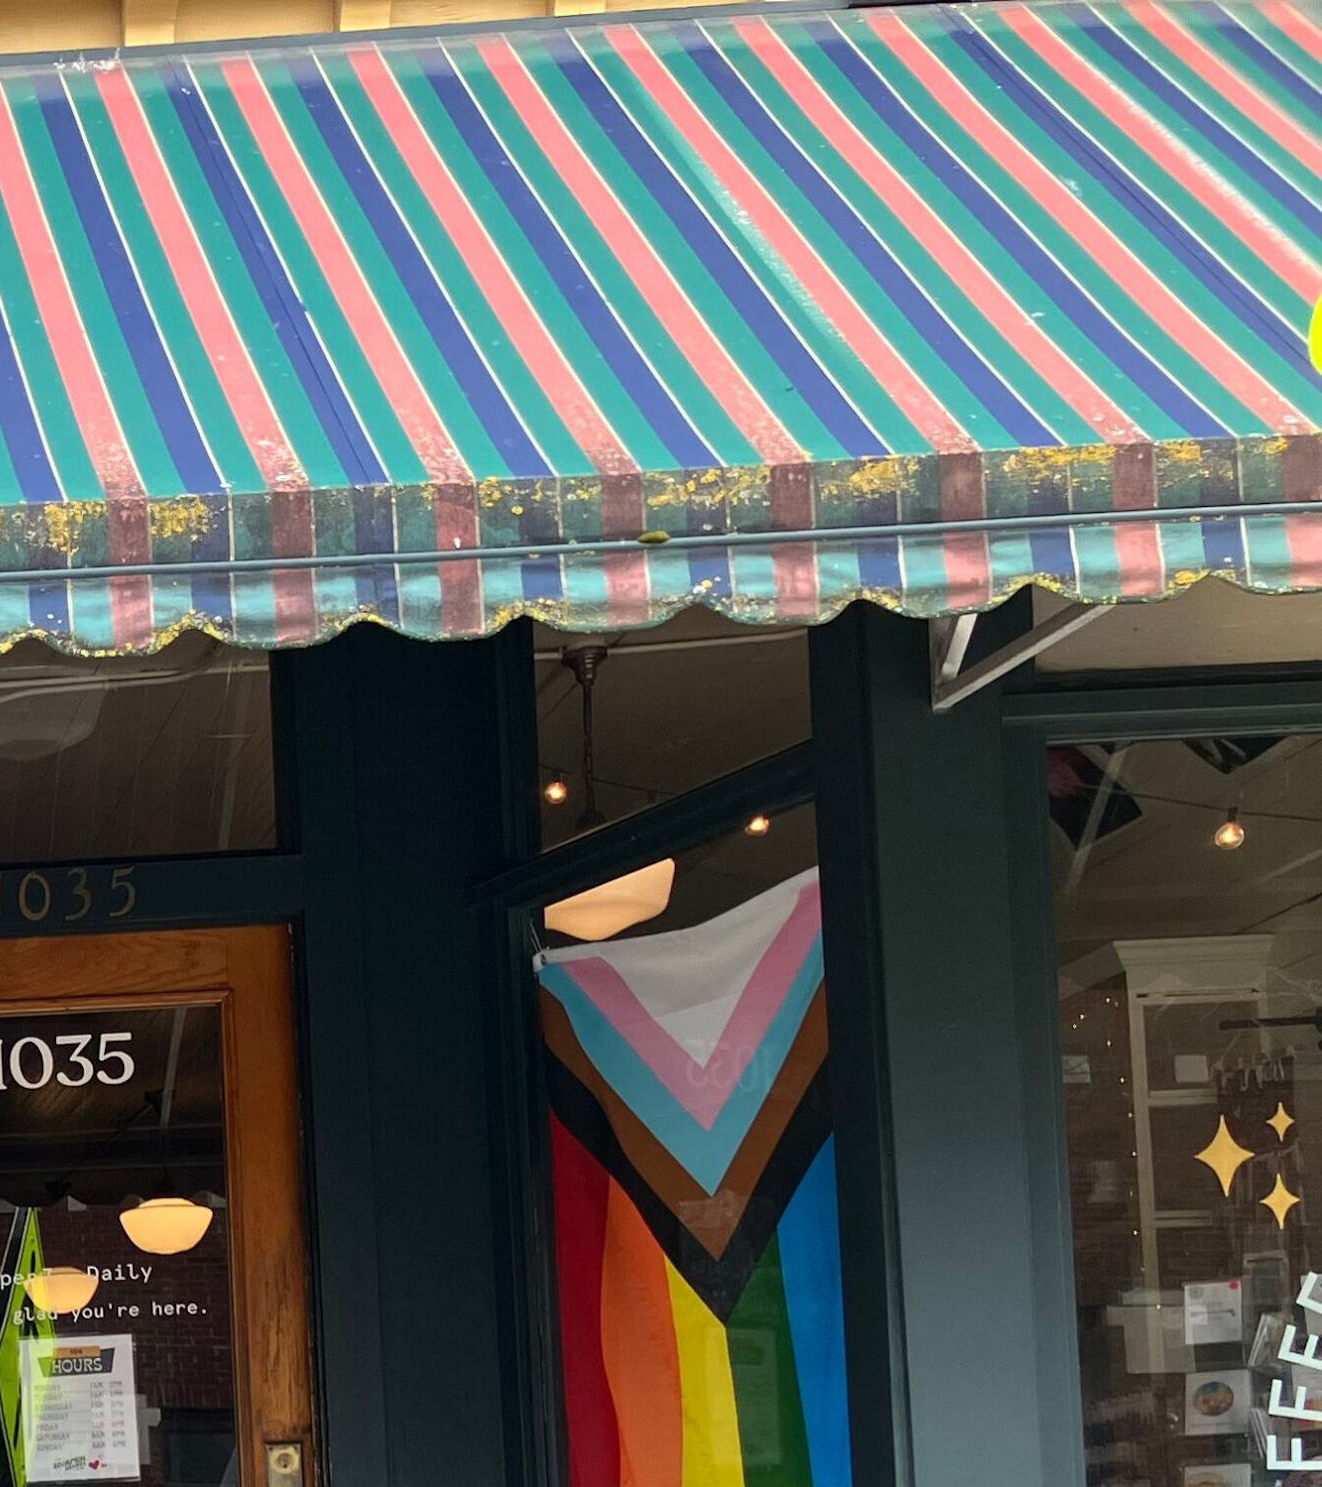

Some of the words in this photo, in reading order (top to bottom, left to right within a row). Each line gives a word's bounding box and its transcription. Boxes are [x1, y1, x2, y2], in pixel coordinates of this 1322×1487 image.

[87, 1263, 153, 1283] Daily
[70, 1303, 140, 1324] you're
[151, 1301, 208, 1316] here.
[52, 1357, 103, 1374] HOURS
